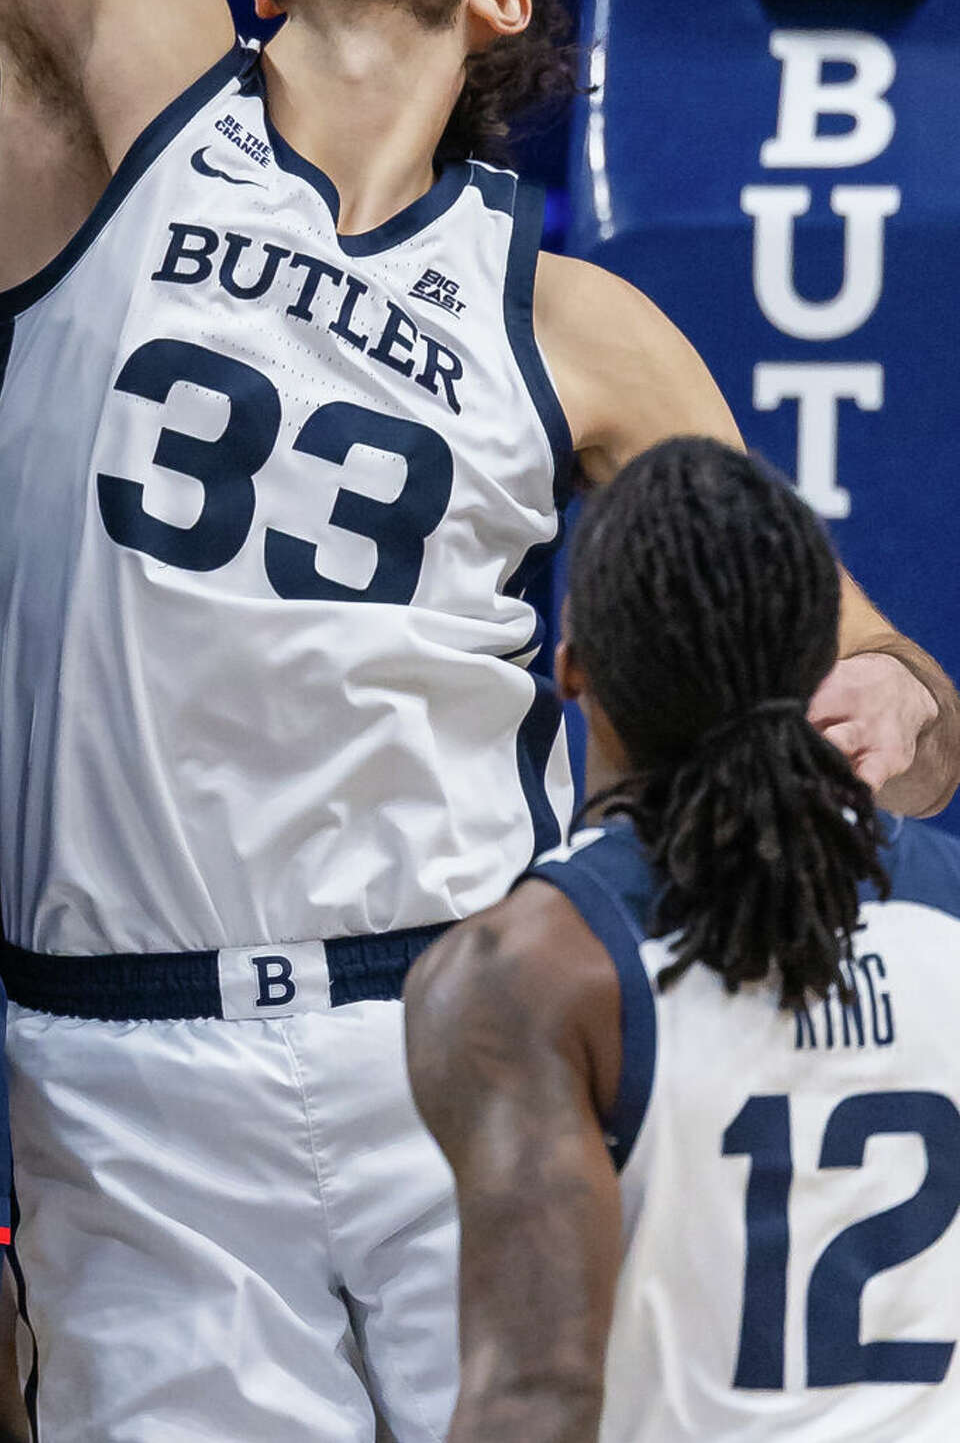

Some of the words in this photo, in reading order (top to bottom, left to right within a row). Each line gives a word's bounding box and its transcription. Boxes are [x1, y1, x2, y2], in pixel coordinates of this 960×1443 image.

[214, 119, 271, 169] CHANGE
[223, 114, 244, 135] BE
[245, 131, 273, 158] THE
[412, 279, 467, 313] EAST
[421, 268, 460, 296] BIG
[741, 29, 901, 519] BUT
[151, 222, 465, 416] BUTLER
[96, 337, 454, 606] 33
[251, 955, 296, 1007] B
[721, 1091, 960, 1391] 12
